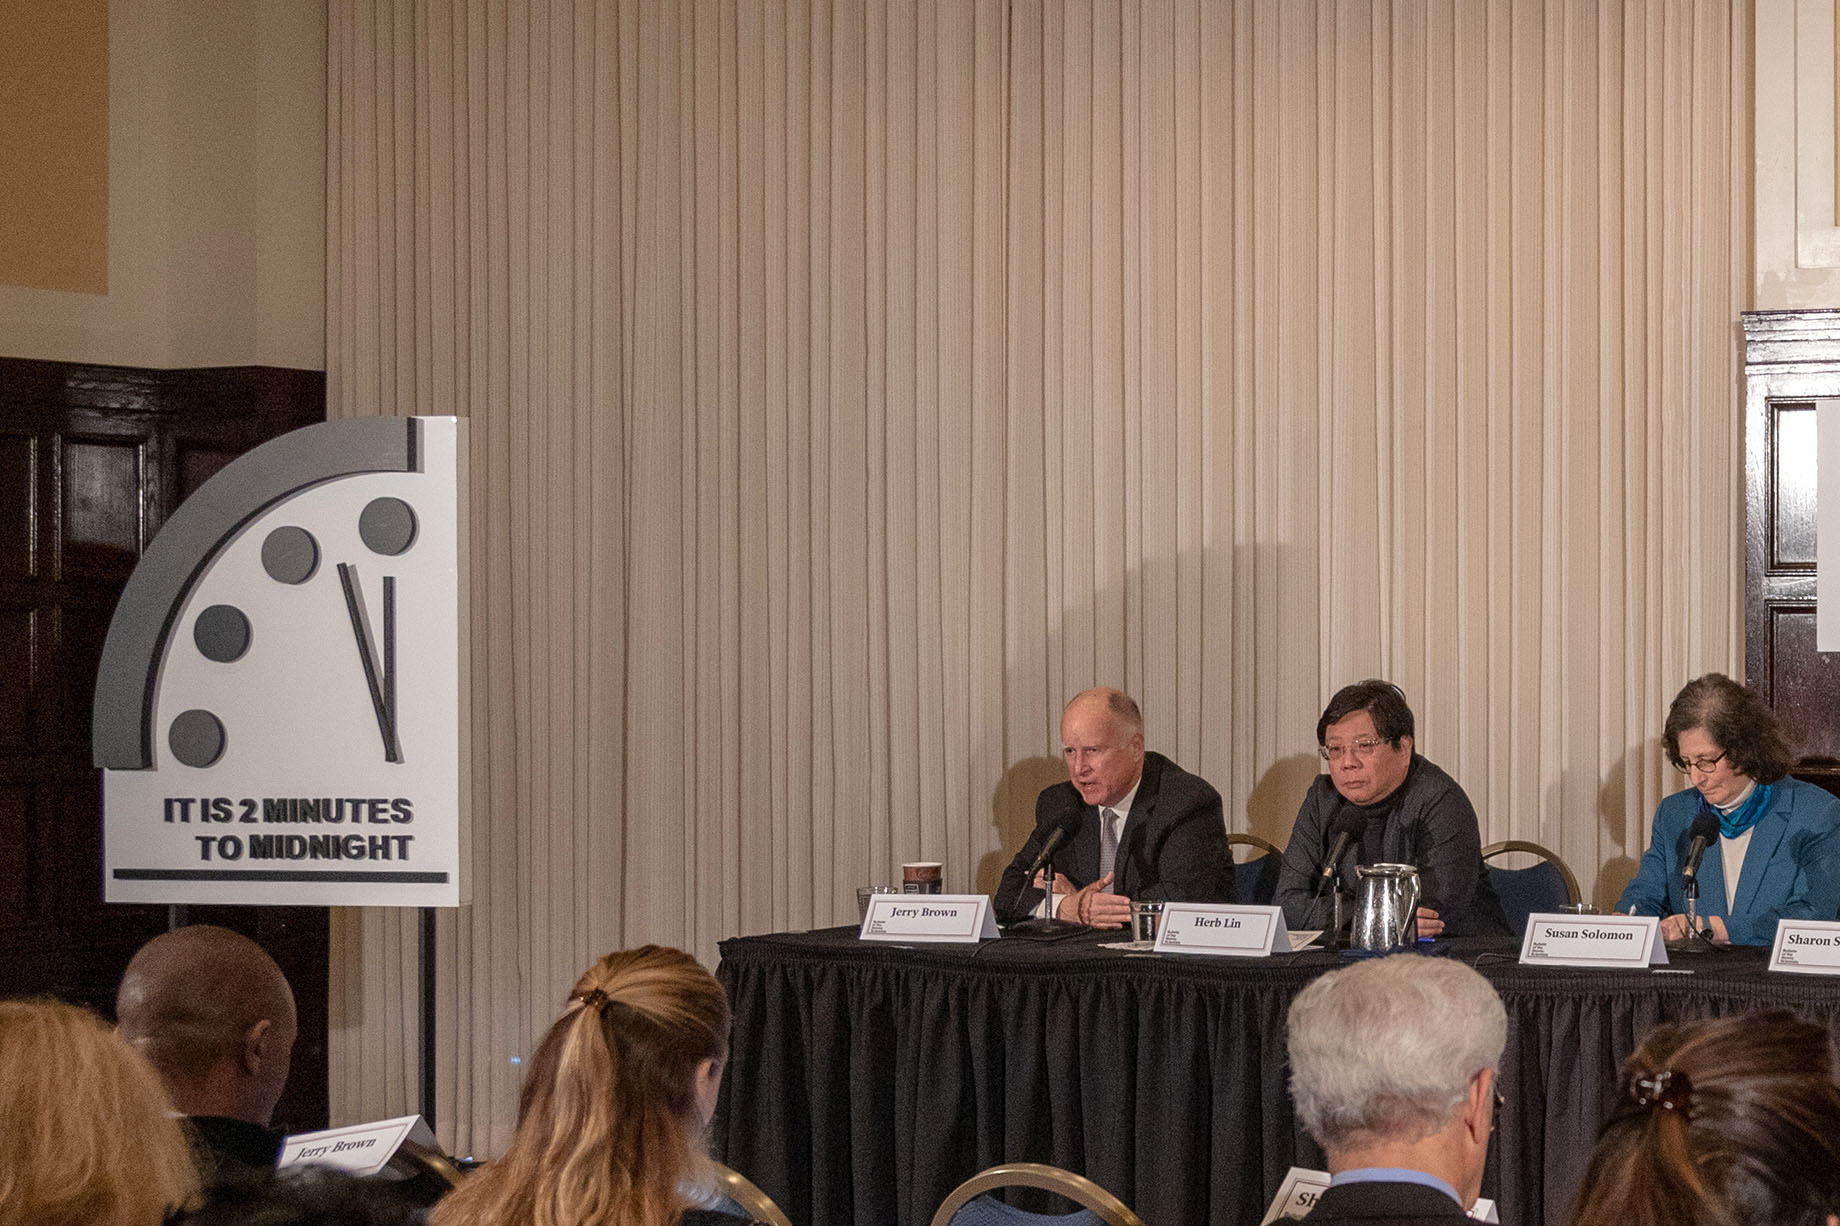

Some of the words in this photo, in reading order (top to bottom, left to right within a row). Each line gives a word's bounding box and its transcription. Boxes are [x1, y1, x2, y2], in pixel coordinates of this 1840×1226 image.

[163, 798, 196, 824] IT
[201, 798, 235, 824] IS
[239, 798, 259, 824] 2
[263, 798, 414, 824] MINUTES
[195, 834, 244, 861] TO
[249, 834, 414, 861] MIDNIGHT
[891, 907, 919, 918] Jerry
[921, 907, 957, 917] Brown
[1194, 917, 1221, 928] Herb
[1224, 918, 1241, 928] Lin
[1545, 928, 1579, 939] Susan
[1581, 929, 1633, 940] Solomon
[1788, 934, 1831, 946] Sharon
[294, 1145, 332, 1161] Jerry
[331, 1139, 377, 1153] Brown
